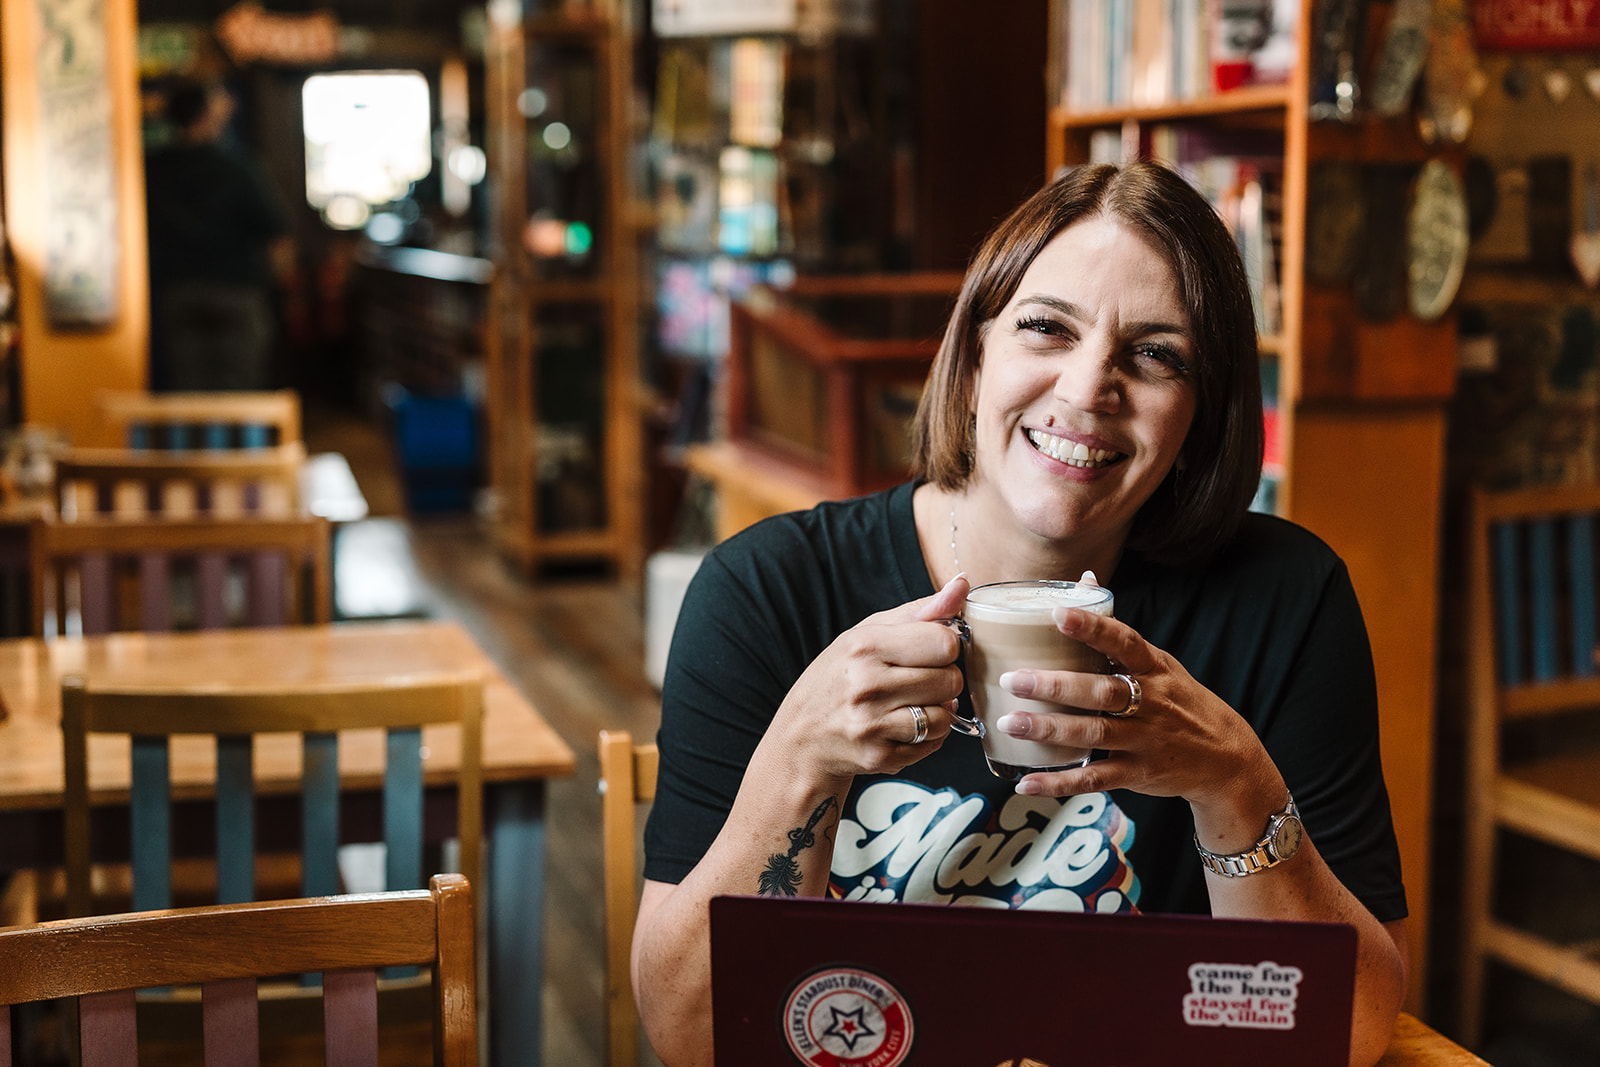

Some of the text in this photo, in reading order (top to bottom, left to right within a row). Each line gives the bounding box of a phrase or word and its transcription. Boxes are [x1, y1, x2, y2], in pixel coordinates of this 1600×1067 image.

[830, 780, 1109, 903] Made
[1195, 967, 1296, 982] came for
[1199, 980, 1291, 996] the hero
[1190, 997, 1290, 1011] stayed for
[793, 975, 884, 1050] ELLEN'S STARDUST DINER
[1190, 1009, 1288, 1024] the villain
[886, 1029, 902, 1052] CITY
